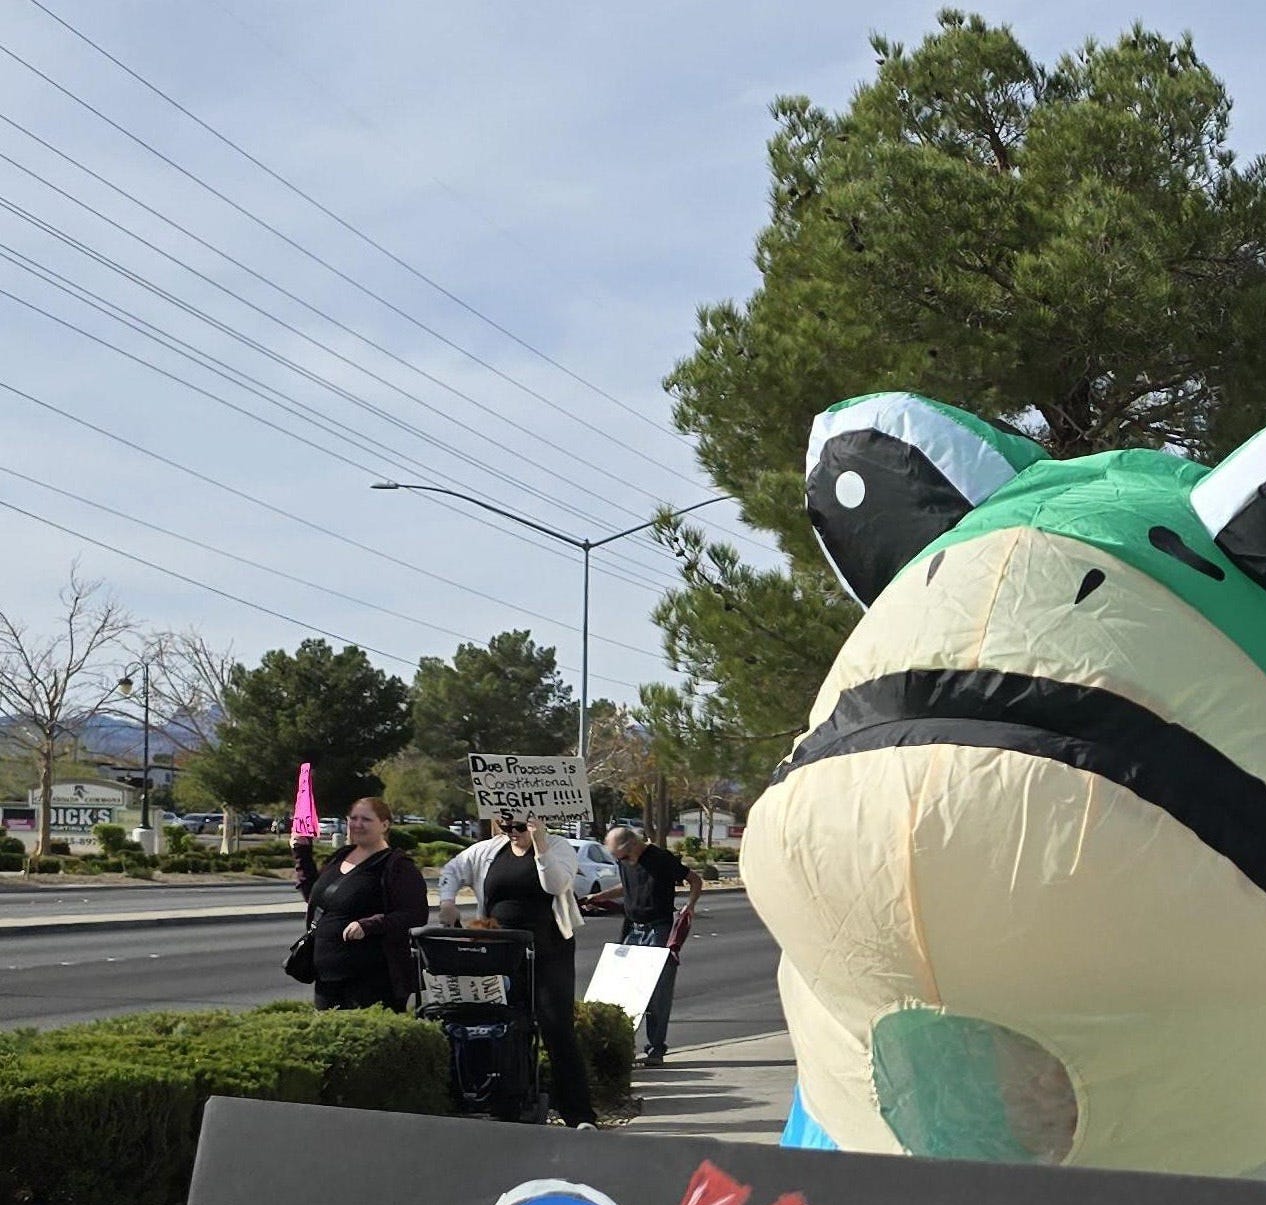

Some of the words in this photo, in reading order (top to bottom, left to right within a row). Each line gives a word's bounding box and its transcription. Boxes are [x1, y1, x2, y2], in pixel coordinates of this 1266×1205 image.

[470, 756, 503, 773] Due
[505, 757, 556, 774] Process
[562, 762, 576, 774] is
[473, 777, 482, 786] a
[484, 773, 574, 790] Constitutional
[478, 790, 548, 807] RIGHT
